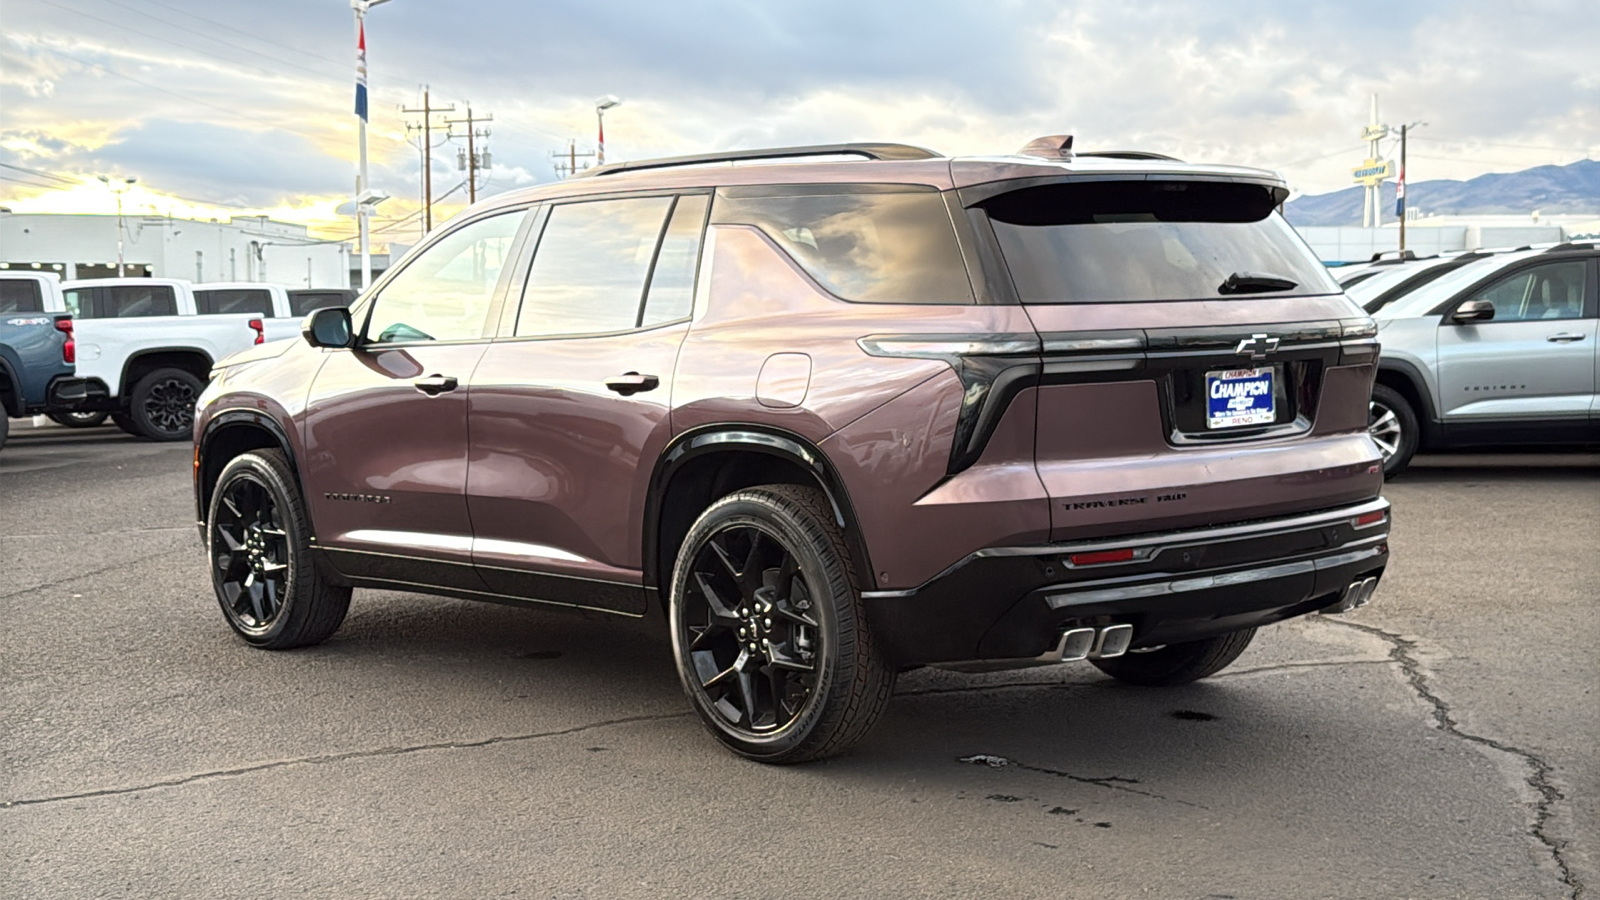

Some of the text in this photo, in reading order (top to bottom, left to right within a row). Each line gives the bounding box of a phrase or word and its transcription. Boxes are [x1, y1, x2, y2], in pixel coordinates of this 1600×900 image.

[1225, 369, 1257, 378] CHAMPION
[1210, 380, 1269, 399] CHAMPION
[1062, 496, 1148, 510] TRAVERSE
